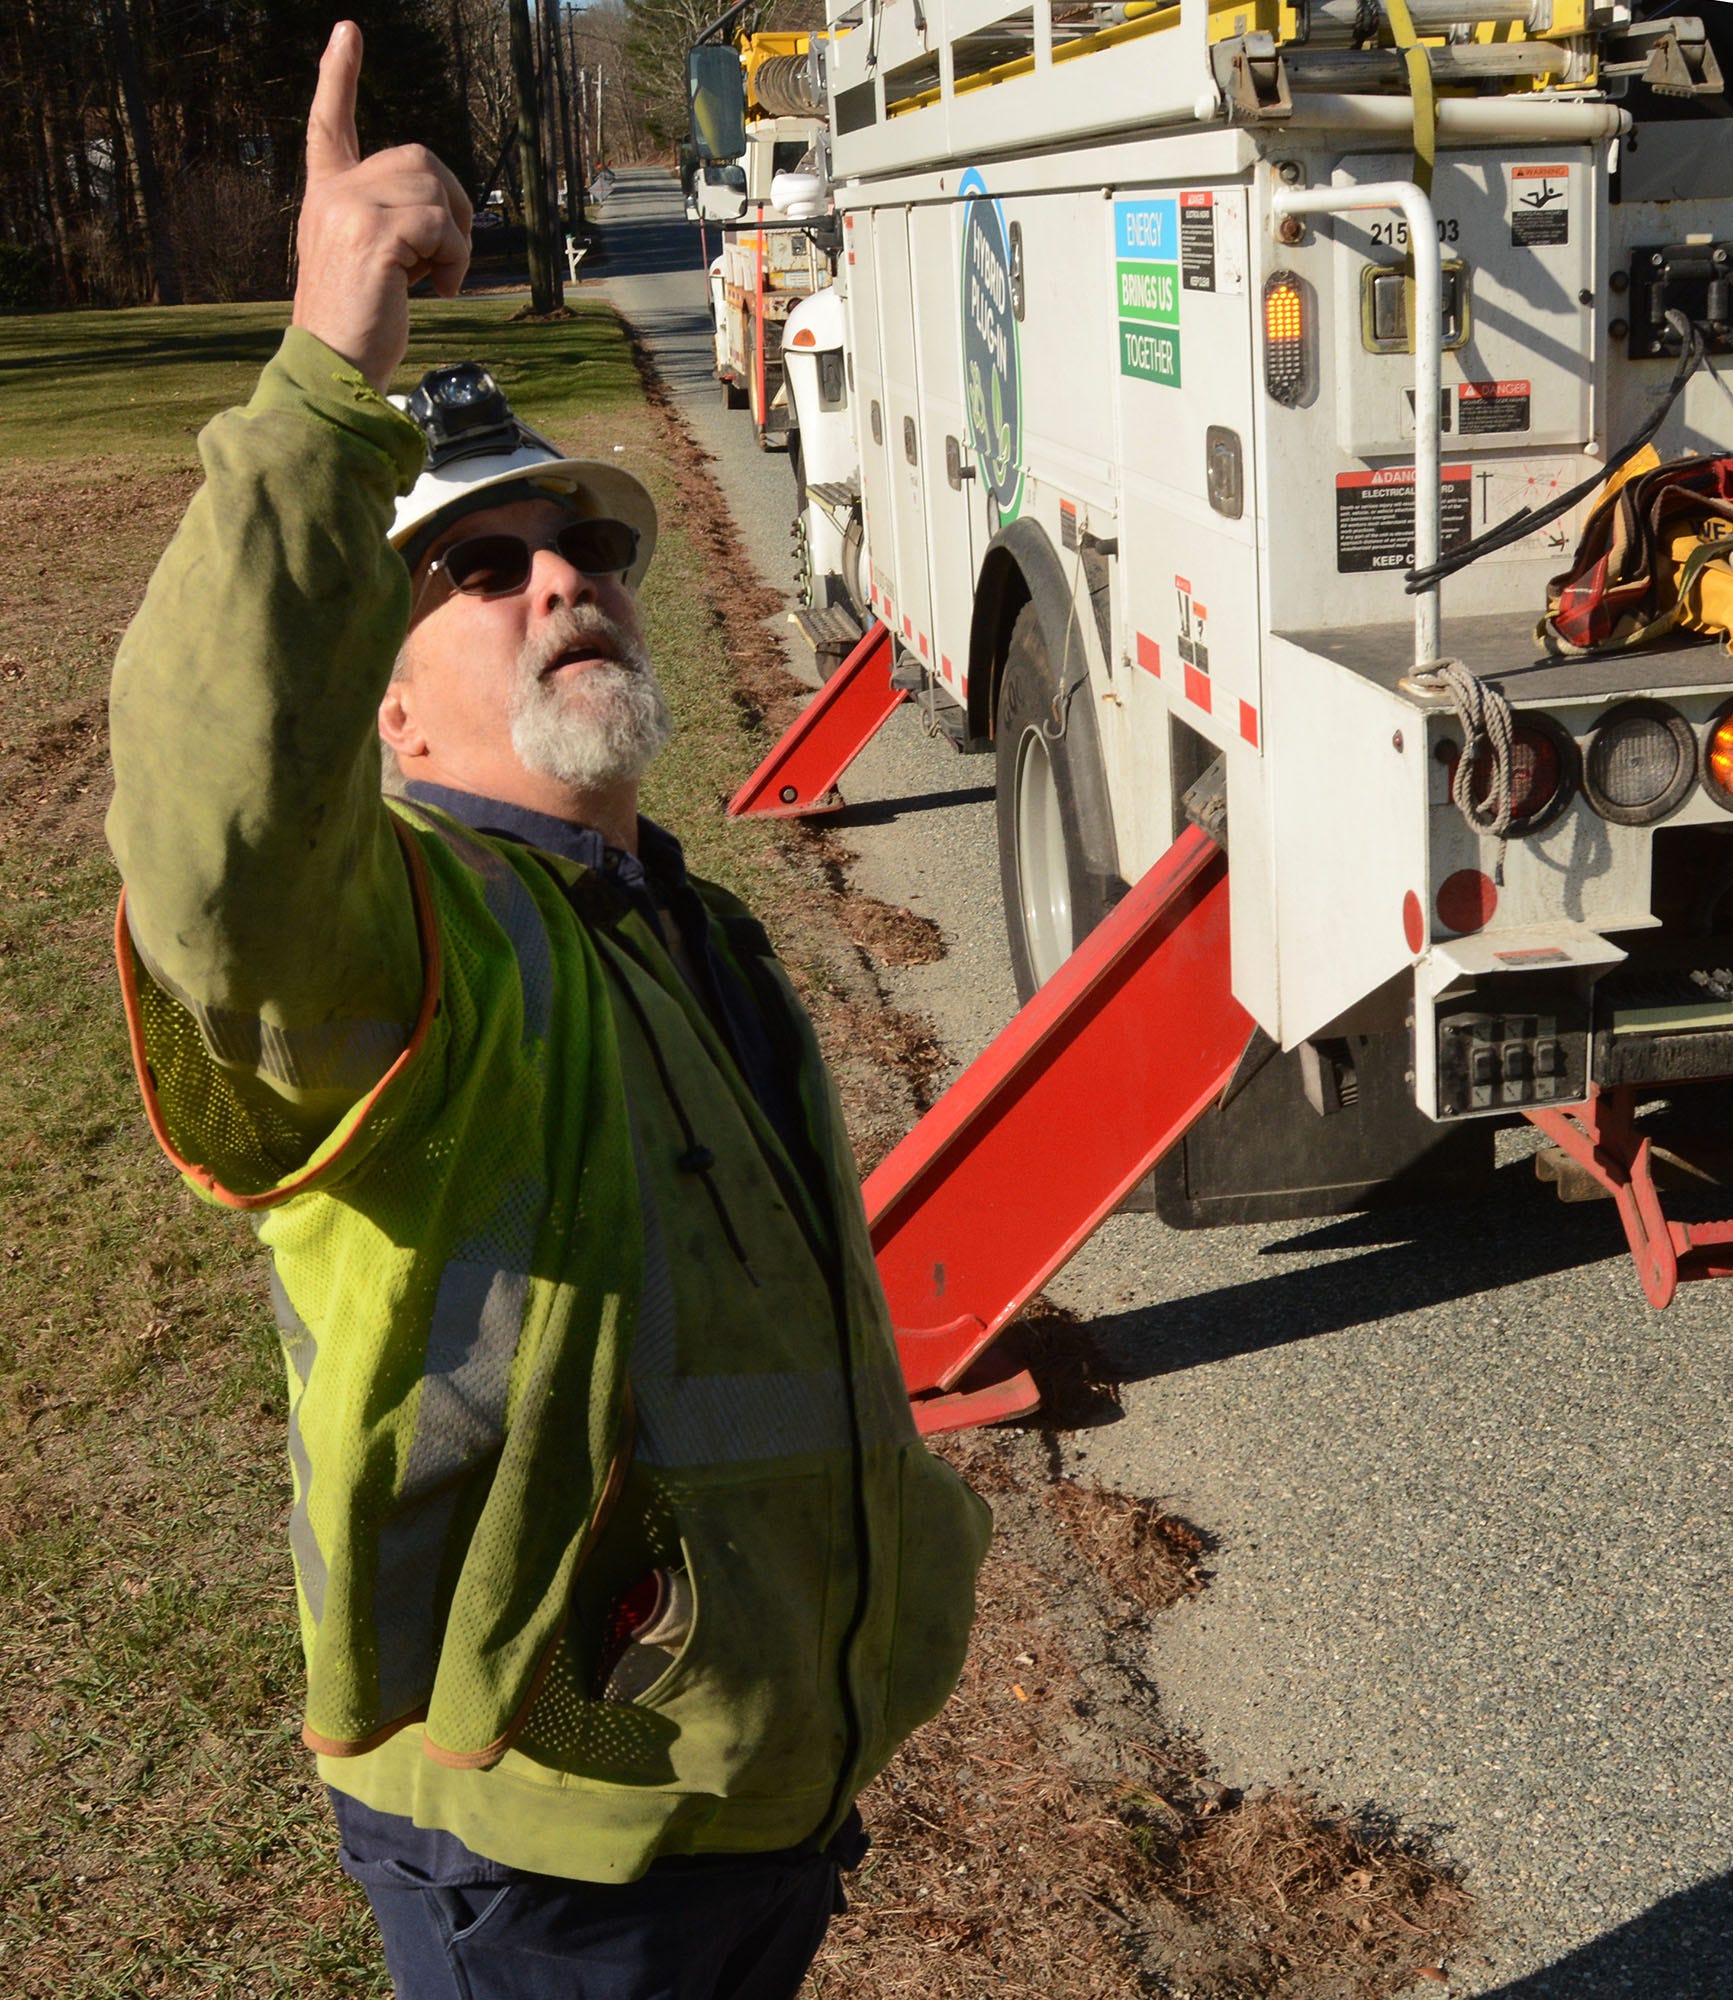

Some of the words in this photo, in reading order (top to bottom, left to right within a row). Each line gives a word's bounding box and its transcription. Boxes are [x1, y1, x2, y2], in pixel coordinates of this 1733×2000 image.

[1126, 211, 1164, 248] ENERGY
[973, 219, 1006, 315] HYBRID
[1121, 273, 1157, 310] BRINGS
[1158, 276, 1174, 312] US
[971, 274, 1007, 382] PLUG-IN
[1125, 333, 1174, 376] TOGETHER
[1481, 383, 1527, 395] DANGER
[1372, 555, 1404, 567] KEEP
